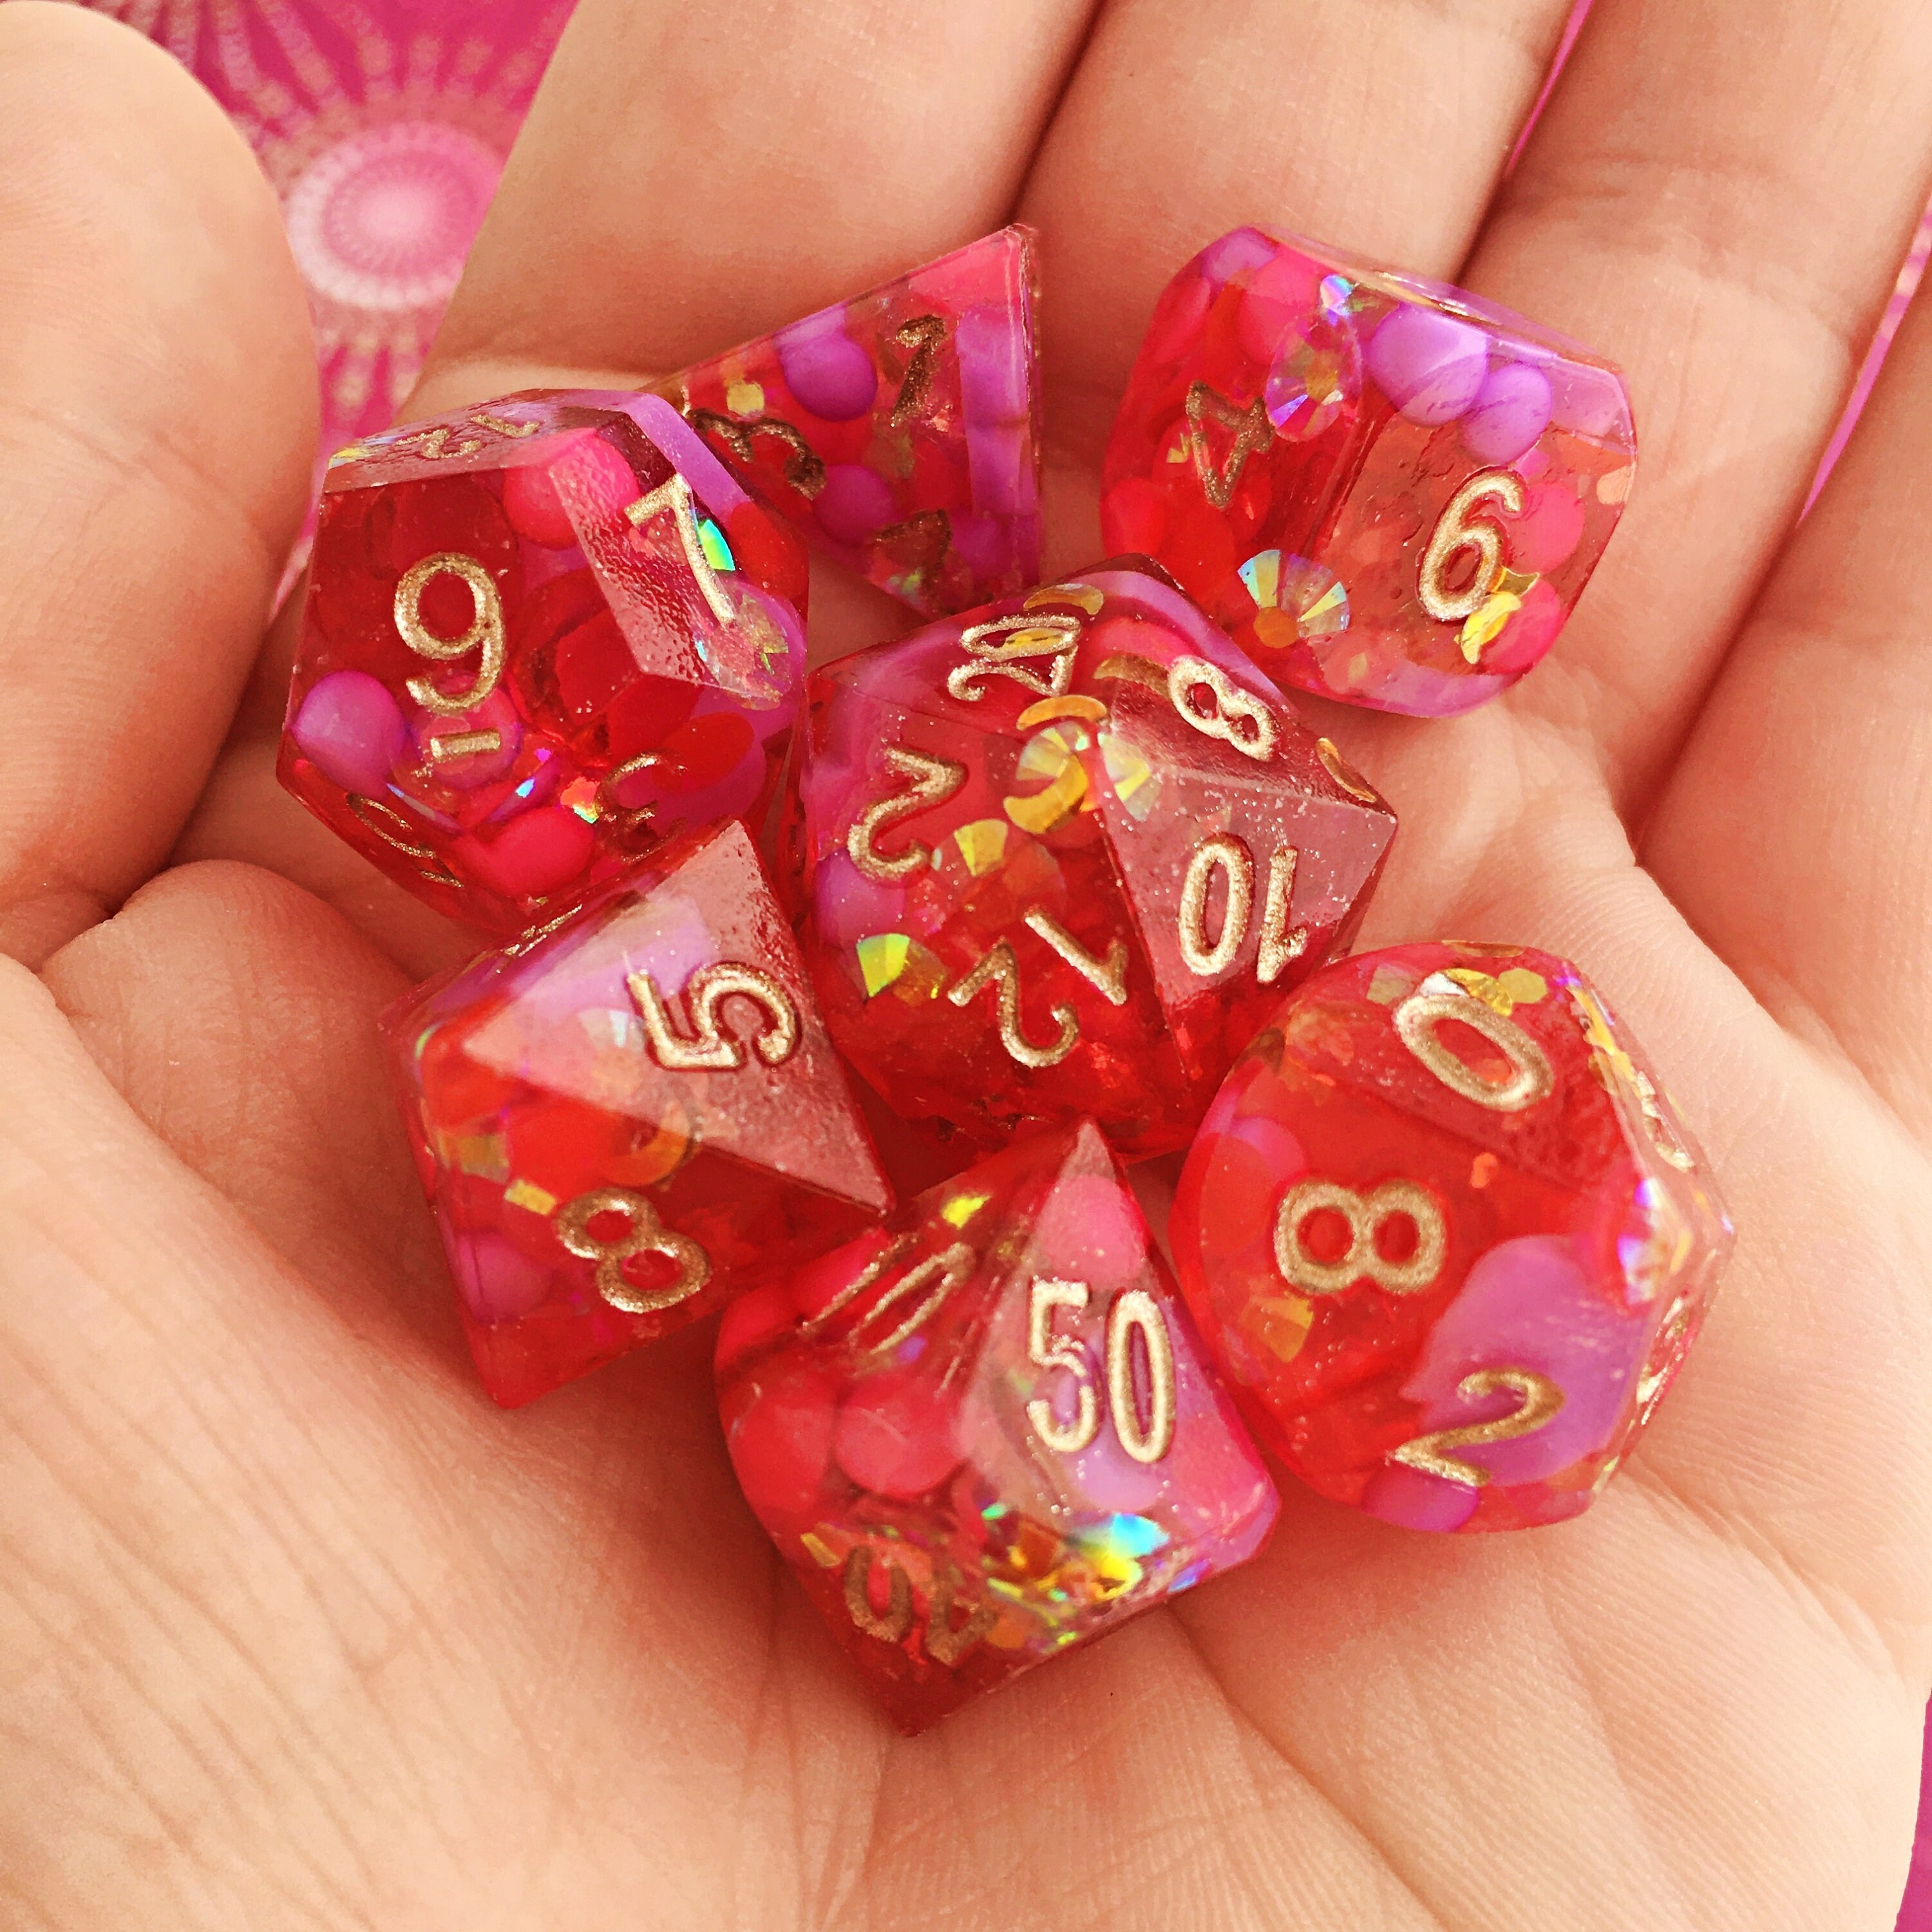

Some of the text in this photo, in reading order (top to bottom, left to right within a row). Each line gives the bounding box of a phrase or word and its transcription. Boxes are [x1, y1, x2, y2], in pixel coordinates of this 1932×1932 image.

[1186, 379, 1275, 511] 4
[623, 473, 737, 625] 7
[1418, 465, 1526, 621] 6
[393, 551, 506, 715] 9
[947, 612, 1082, 702] 20
[1168, 654, 1276, 761] 8
[847, 747, 967, 880] 2
[1178, 832, 1308, 984] 10
[625, 961, 800, 1070] 5
[947, 906, 1129, 1068] 12
[1394, 992, 1554, 1113] 0
[555, 1188, 712, 1314] 8
[1274, 1180, 1448, 1296] 8
[1027, 1279, 1177, 1463] 50
[1388, 1366, 1566, 1488] 2
